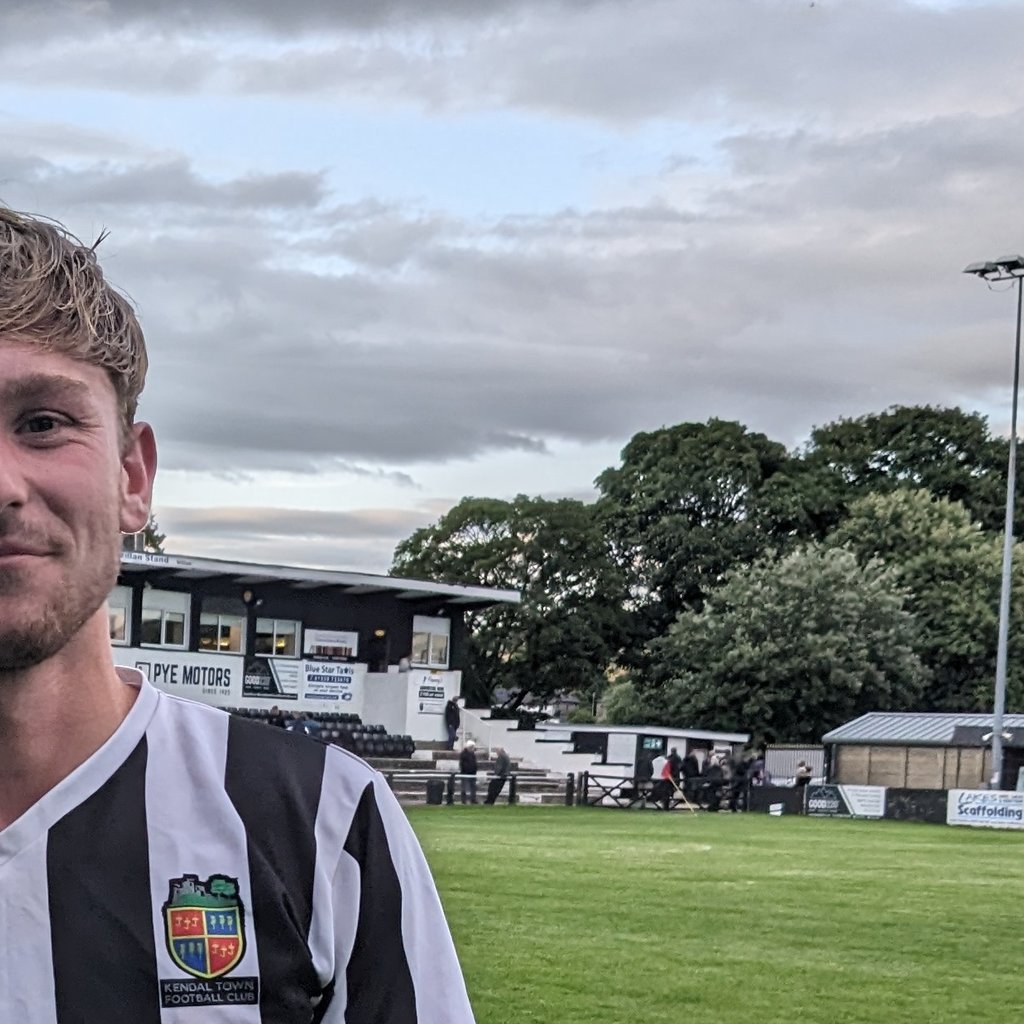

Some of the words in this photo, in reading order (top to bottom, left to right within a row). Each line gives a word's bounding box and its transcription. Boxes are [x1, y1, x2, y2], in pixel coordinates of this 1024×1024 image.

[145, 554, 169, 564] Stand
[153, 663, 178, 684] PYE
[182, 665, 231, 687] MOTORS
[305, 664, 320, 673] Blue
[321, 665, 335, 674] Star
[957, 804, 1023, 821] Scaffolding
[163, 982, 213, 993] KENDAL
[216, 981, 255, 991] TOWN
[164, 993, 225, 1005] FOOTBALL
[226, 992, 255, 1003] CLUB
